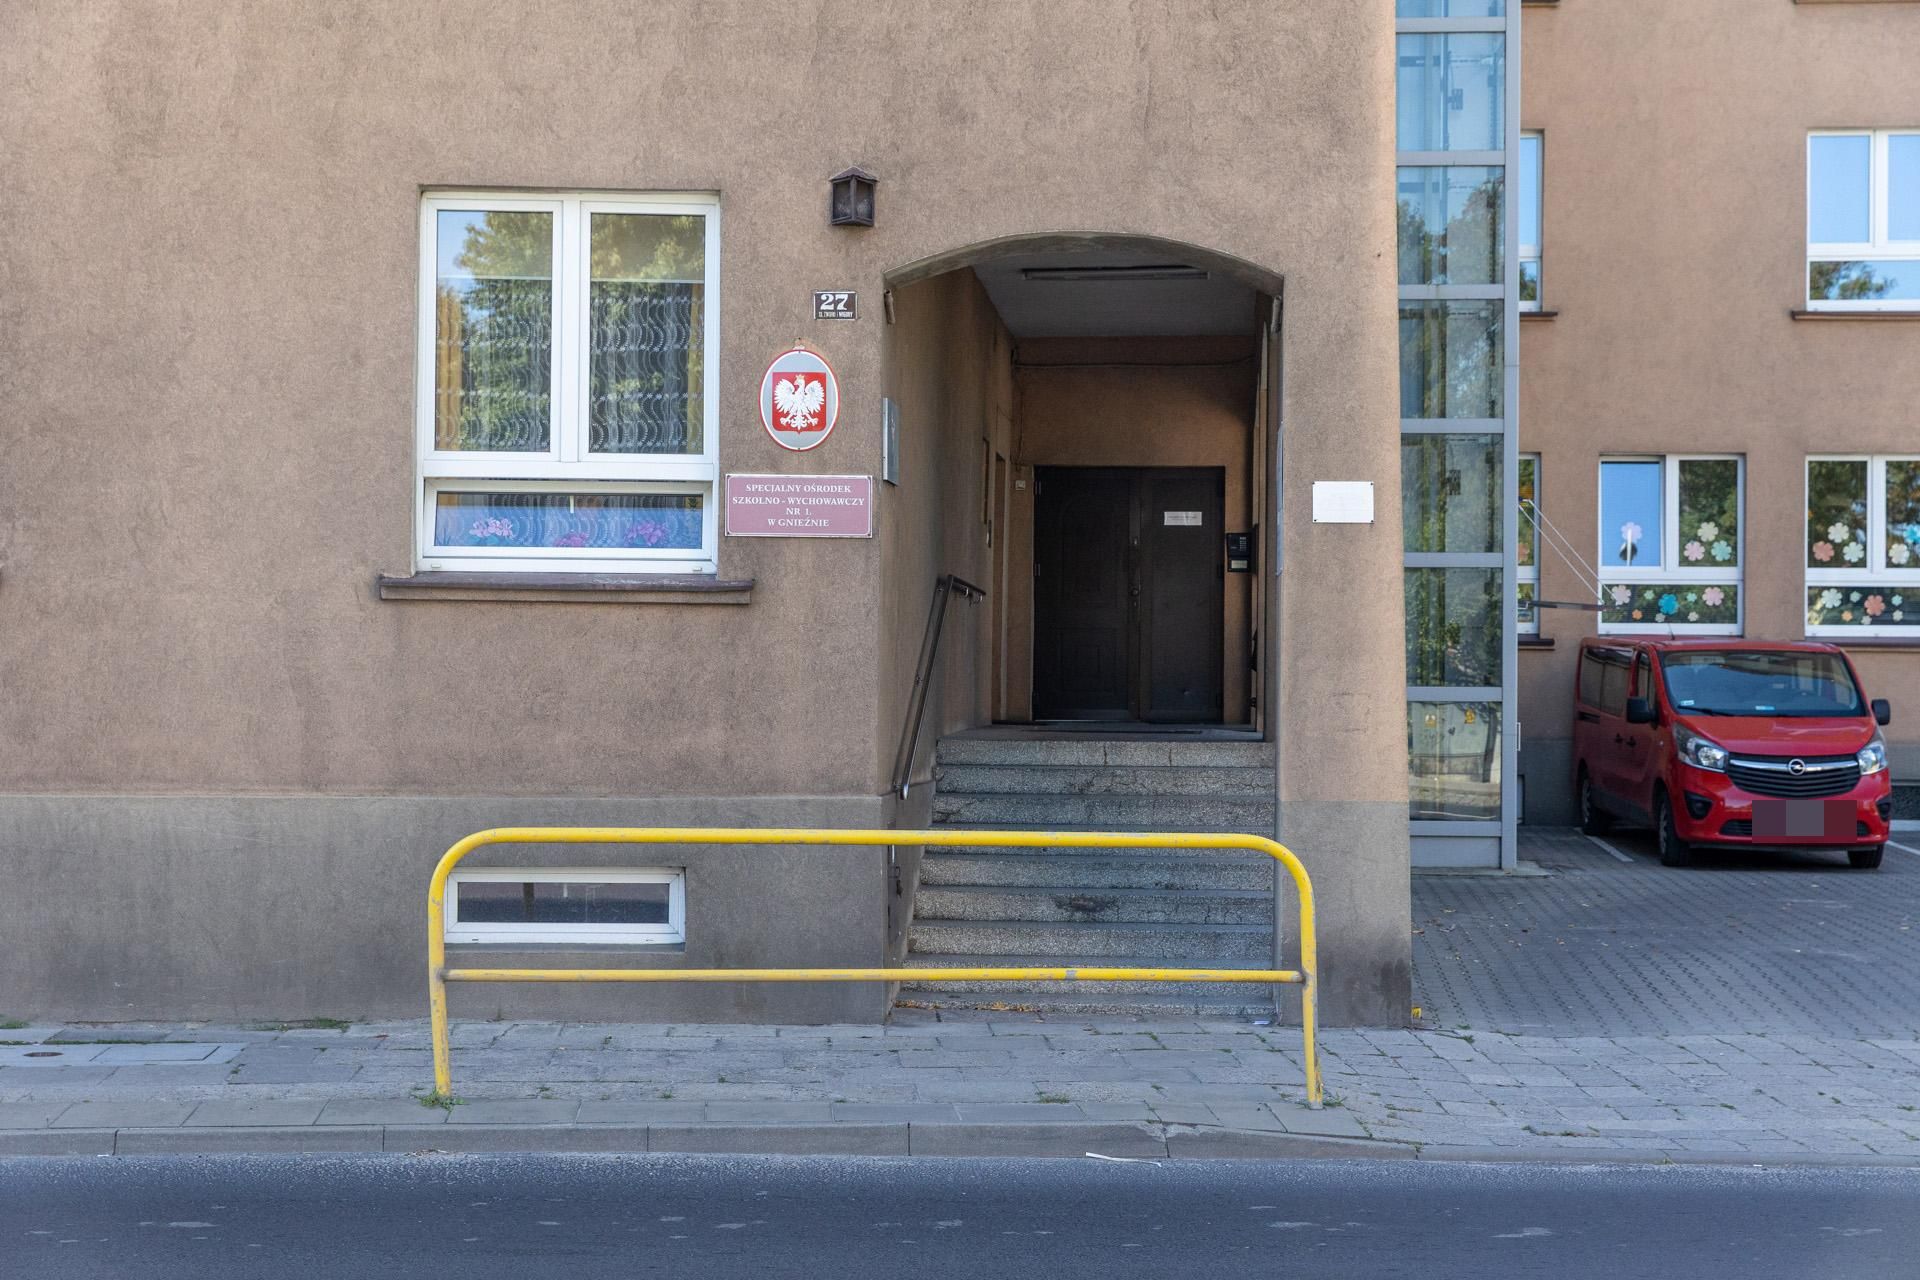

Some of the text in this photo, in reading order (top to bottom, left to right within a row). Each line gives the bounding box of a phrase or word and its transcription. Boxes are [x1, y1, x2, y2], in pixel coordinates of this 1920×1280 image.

[820, 293, 849, 310] 27
[745, 483, 852, 493] SPECJALNY OŚRODEK
[732, 497, 780, 505] SZKOLNO
[787, 497, 865, 506] WYCHOWAWCZY
[786, 507, 801, 516] NR
[767, 517, 830, 527] W GNIEŹNIE
